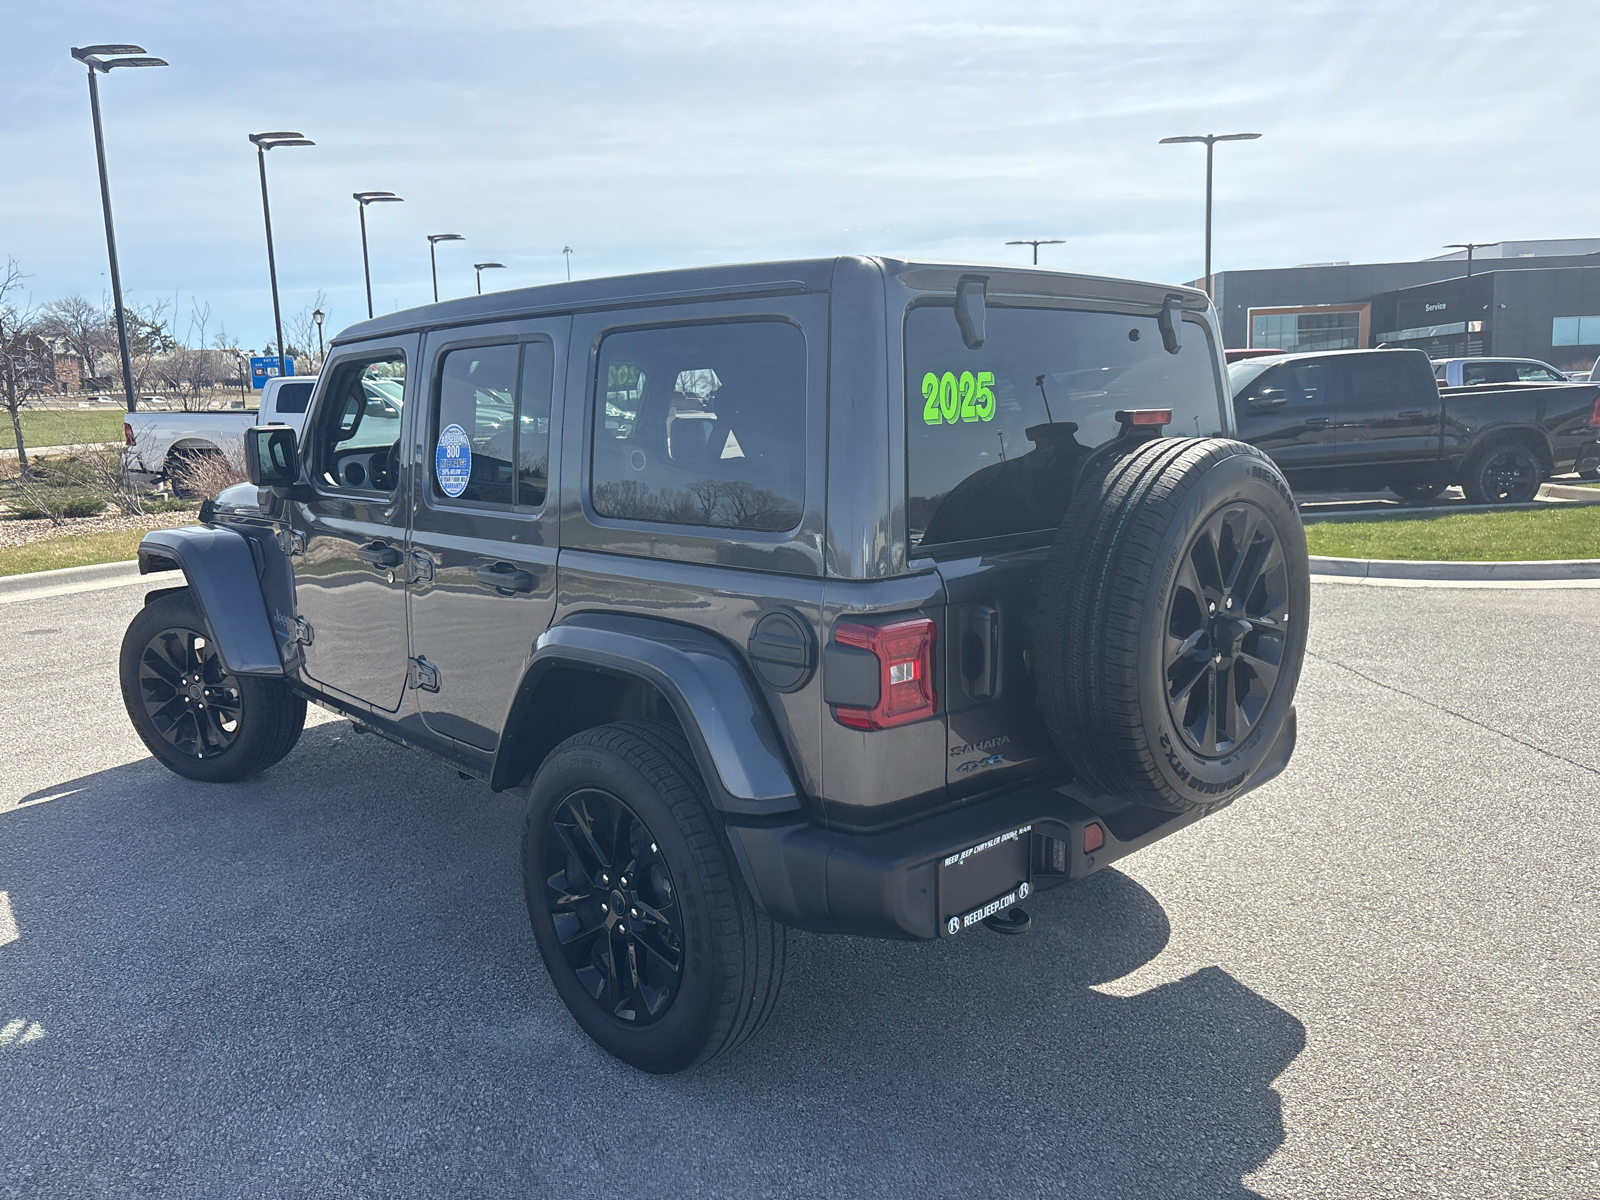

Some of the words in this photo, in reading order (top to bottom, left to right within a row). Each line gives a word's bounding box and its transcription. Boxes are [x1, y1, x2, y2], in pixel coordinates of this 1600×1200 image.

[1425, 302, 1447, 312] Service
[922, 370, 997, 425] 2025
[440, 459, 451, 467] MILE
[451, 459, 466, 467] RANGE
[446, 445, 460, 458] 800
[1251, 465, 1295, 513] NEXEN
[950, 735, 1011, 757] SAHARA
[944, 853, 960, 867] REED
[959, 847, 974, 861] JEEP
[973, 835, 1001, 855] CHRYSLER
[1000, 829, 1018, 843] DODGE
[1018, 824, 1032, 835] RAM
[963, 892, 1016, 928] REEDJEEP.COM
